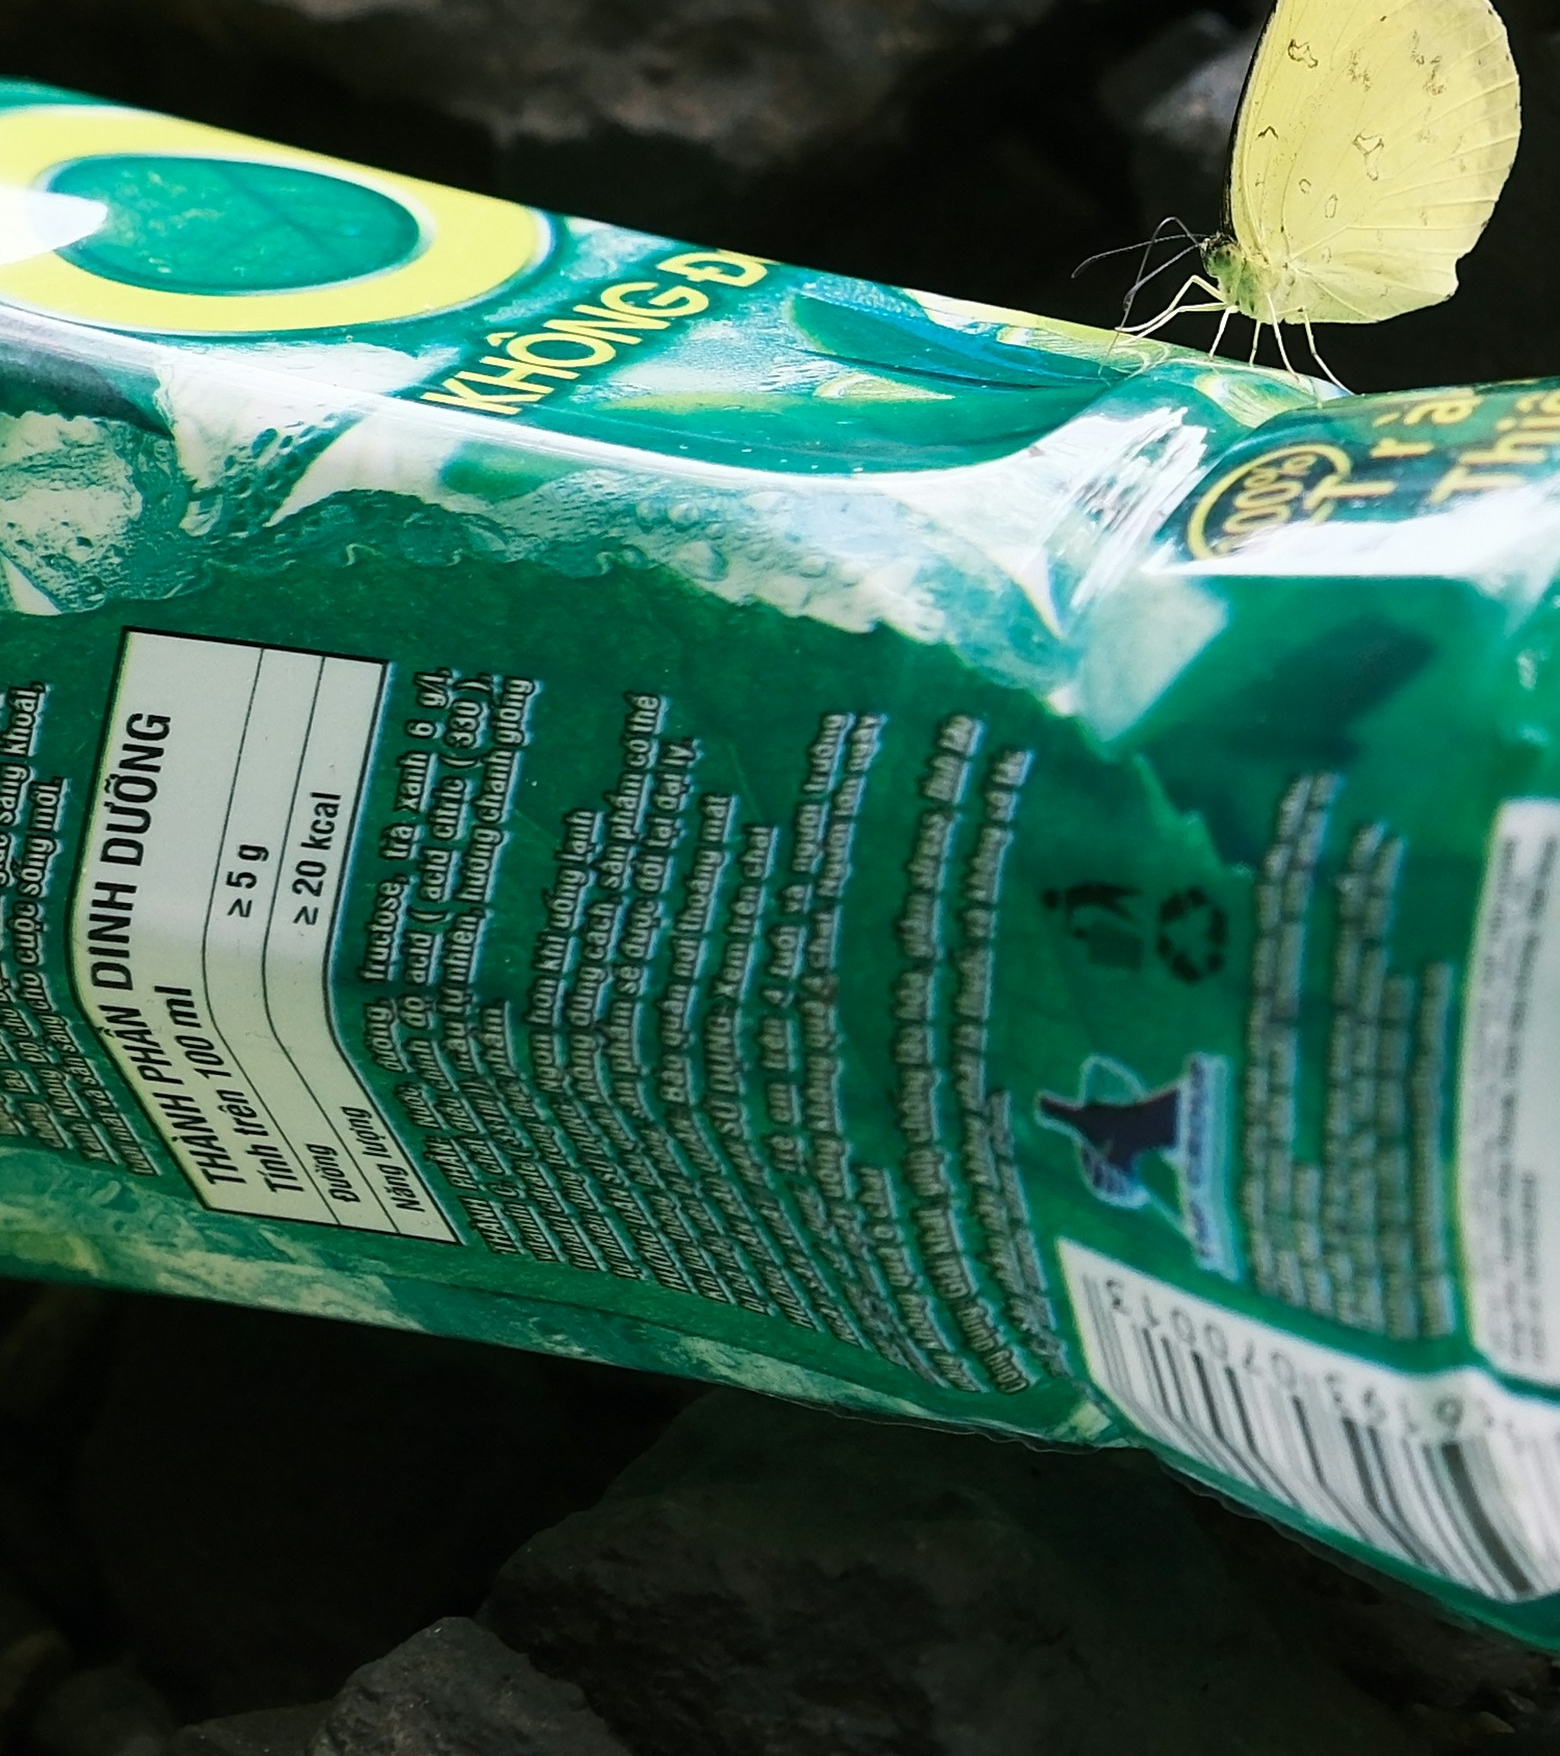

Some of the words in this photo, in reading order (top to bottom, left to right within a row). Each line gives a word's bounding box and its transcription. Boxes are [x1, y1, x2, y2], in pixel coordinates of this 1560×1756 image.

[421, 281, 707, 412] KHÔNG
[408, 719, 435, 737] 6
[488, 673, 535, 746] giống
[617, 688, 659, 735] thể
[392, 749, 428, 810] xanh
[619, 733, 650, 768] có
[100, 712, 171, 867] DƯỠNG
[425, 772, 463, 839] citric
[473, 746, 514, 824] chanh
[600, 767, 647, 840] phẩm
[298, 787, 343, 853] kcal
[377, 818, 414, 862] trà
[561, 806, 598, 863] lạnh
[7, 833, 54, 896] sống
[225, 867, 258, 891] 5
[236, 840, 270, 864] g
[290, 856, 328, 899] 20
[414, 845, 449, 901] acid
[590, 839, 627, 890] sản
[354, 868, 407, 982] fructose,
[538, 864, 587, 929] uống
[9, 898, 39, 966] cuộc
[91, 876, 138, 995] DINH
[397, 928, 433, 985] acid
[534, 931, 566, 972] khi
[17, 969, 48, 1011] cho
[712, 938, 746, 999] Xem
[156, 981, 201, 1029] ml
[99, 1000, 185, 1088] PHẦN
[175, 1031, 232, 1084] 100
[155, 1089, 247, 1192] THÀNH
[212, 1084, 268, 1140] trên
[342, 1104, 392, 1161] lượng
[249, 1140, 303, 1198] Tính
[306, 1141, 360, 1205] Đường
[373, 1161, 425, 1214] Năng
[460, 1194, 517, 1256] THÀNH
